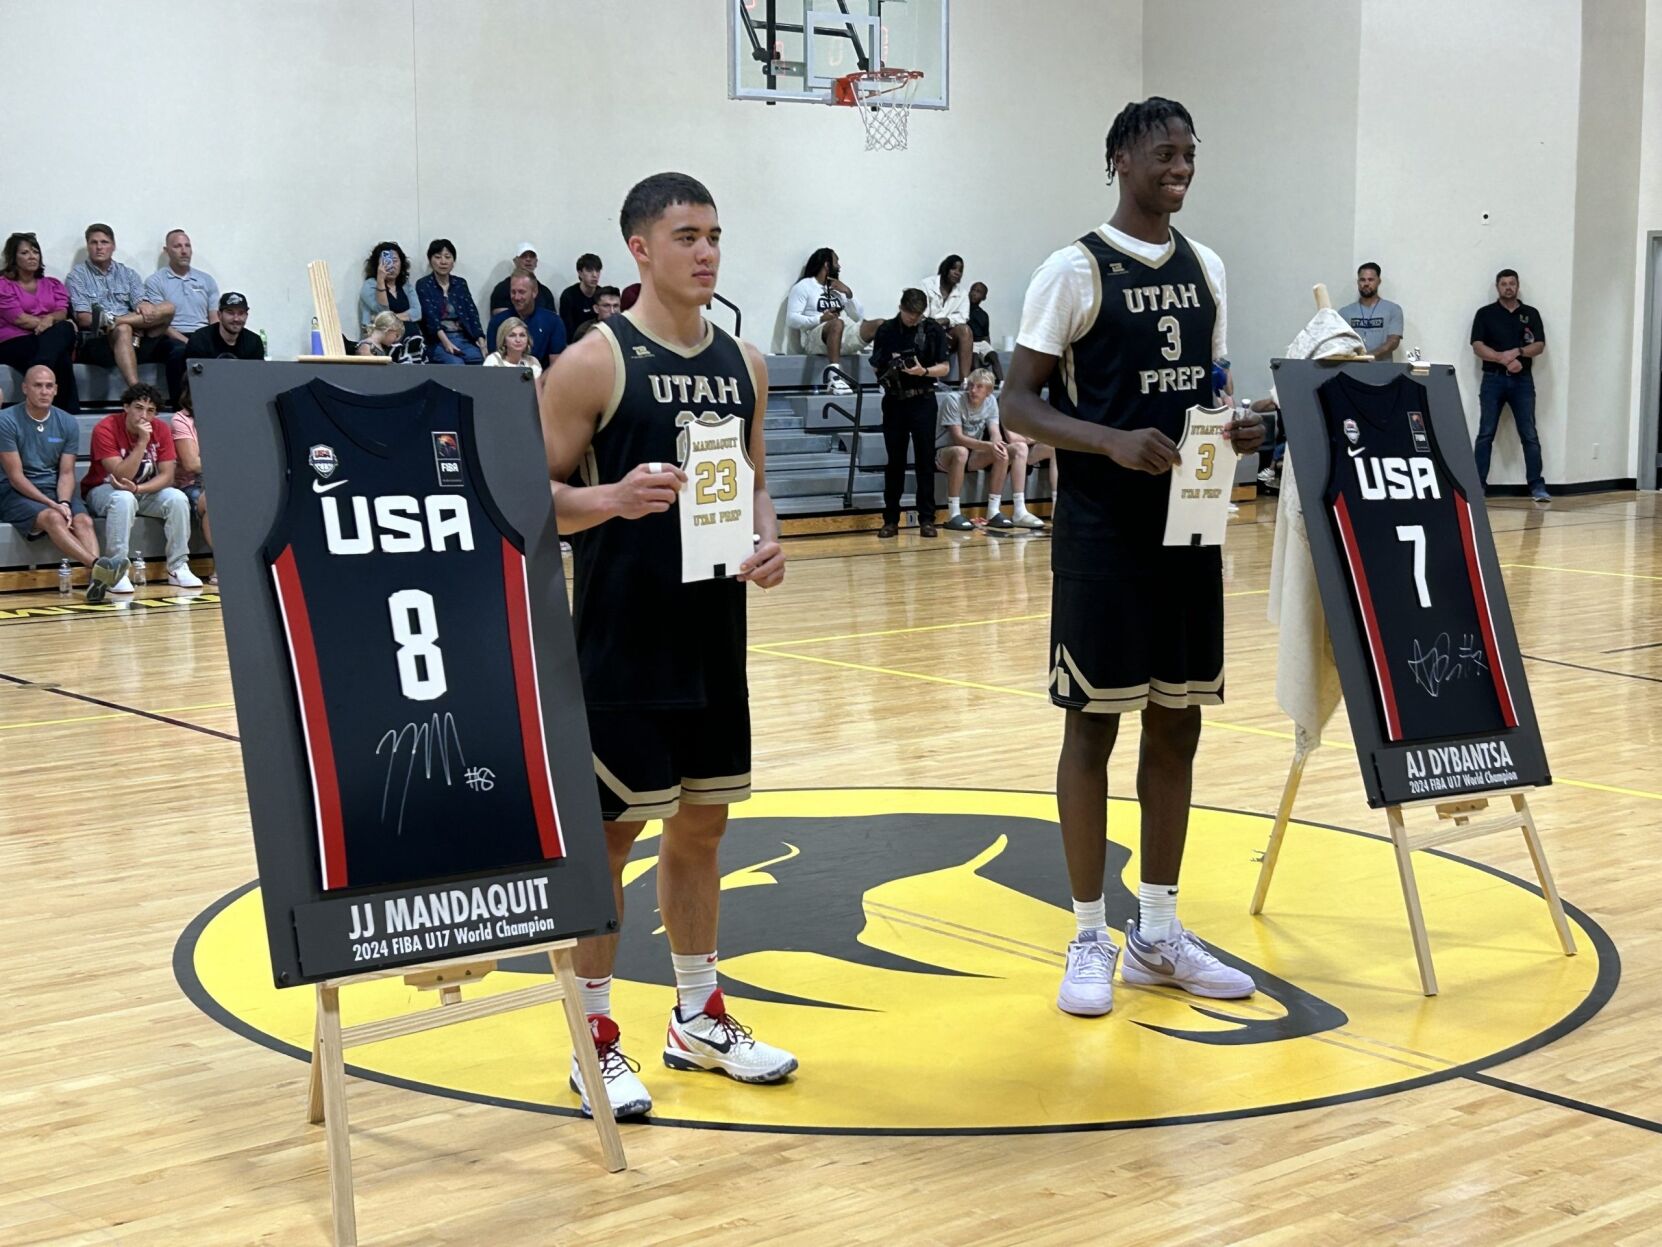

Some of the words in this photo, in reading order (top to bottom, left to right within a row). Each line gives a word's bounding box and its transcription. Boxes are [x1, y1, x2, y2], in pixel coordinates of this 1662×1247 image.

[1123, 284, 1200, 313] UTAH
[1157, 315, 1182, 361] 3
[648, 375, 741, 404] UTAH
[1139, 366, 1205, 394] PREP
[695, 458, 737, 505] 23
[1195, 443, 1216, 481] 3
[1355, 458, 1441, 499] USA
[320, 495, 475, 555] USA
[1395, 525, 1432, 608] 7
[388, 589, 448, 702] 8
[1406, 750, 1427, 779] AJ
[1427, 740, 1514, 776] DYBANTSA
[1409, 779, 1430, 794] 2024
[1430, 776, 1448, 792] FIBA
[1448, 775, 1462, 789] U17
[1463, 770, 1485, 786] World
[1485, 765, 1519, 785] Champion
[349, 903, 375, 939] JJ
[385, 877, 549, 934] MANDAQUIT
[353, 942, 389, 962] 2024
[392, 934, 423, 953] FIBA
[425, 930, 450, 951] U17
[455, 922, 493, 944] World
[495, 915, 555, 939] Champion
